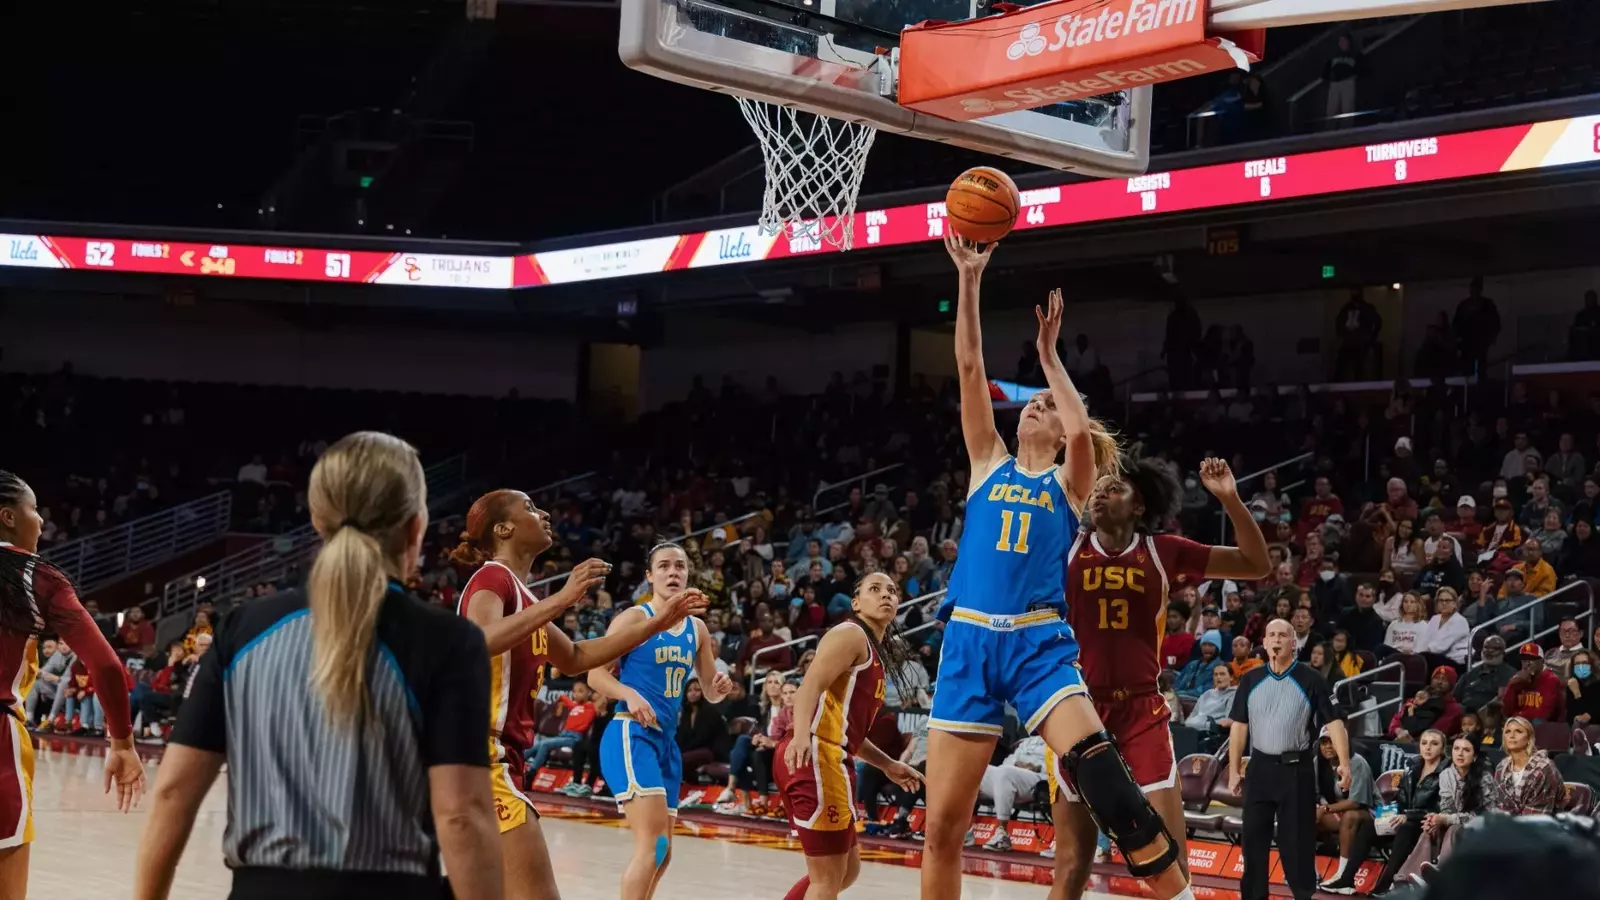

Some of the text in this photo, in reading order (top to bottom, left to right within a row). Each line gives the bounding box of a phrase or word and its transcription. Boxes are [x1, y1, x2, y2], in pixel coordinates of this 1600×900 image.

[1365, 137, 1438, 162] TURNOVERS
[1244, 157, 1286, 178] STEALS
[1395, 160, 1407, 180] 8
[1127, 172, 1170, 193] ASSISTS
[1141, 190, 1156, 211] 10
[1026, 206, 1045, 225] 44
[867, 225, 880, 244] 31
[85, 241, 115, 267] 52
[1209, 238, 1239, 256] 105
[325, 253, 351, 278] 51
[431, 258, 491, 274] TROJANS
[988, 483, 1054, 514] UCLA
[995, 509, 1032, 554] 11
[1083, 566, 1145, 594] USC
[1098, 598, 1129, 630] 13
[655, 645, 692, 669] UCLA
[664, 666, 686, 698] 10
[827, 805, 839, 824] SC
[974, 831, 991, 840] ARGO
[1187, 857, 1213, 869] FARGO
[1190, 848, 1217, 860] WELLS
